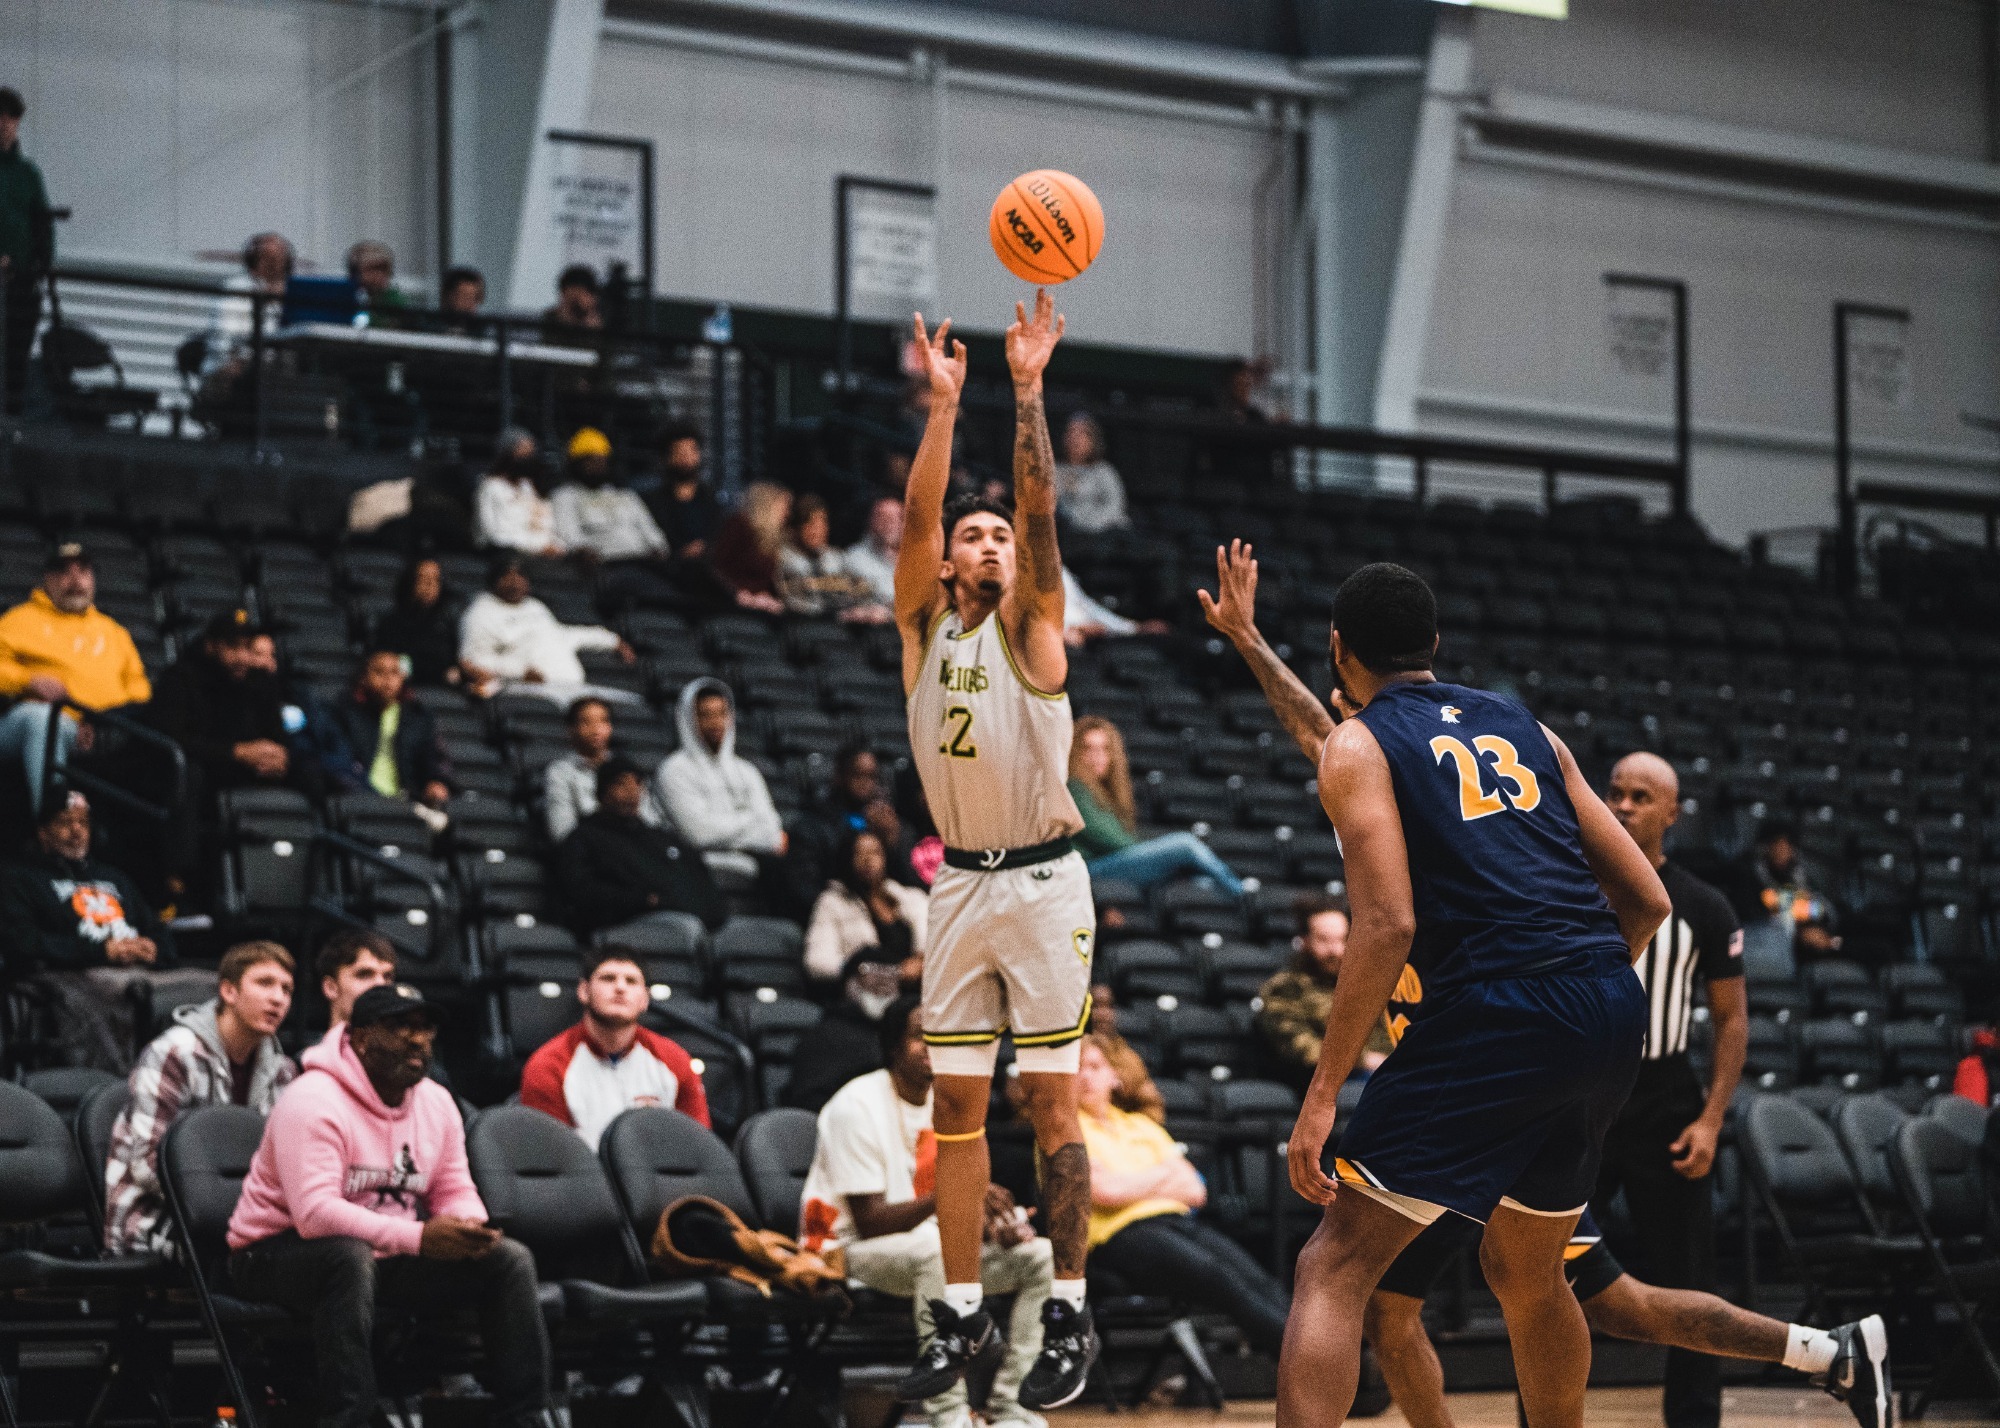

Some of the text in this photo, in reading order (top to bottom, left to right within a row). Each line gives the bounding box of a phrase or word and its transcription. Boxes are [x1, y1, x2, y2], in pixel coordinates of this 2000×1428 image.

[1005, 208, 1045, 255] NCAA
[1027, 180, 1076, 244] Wilson
[1429, 735, 1541, 821] 23
